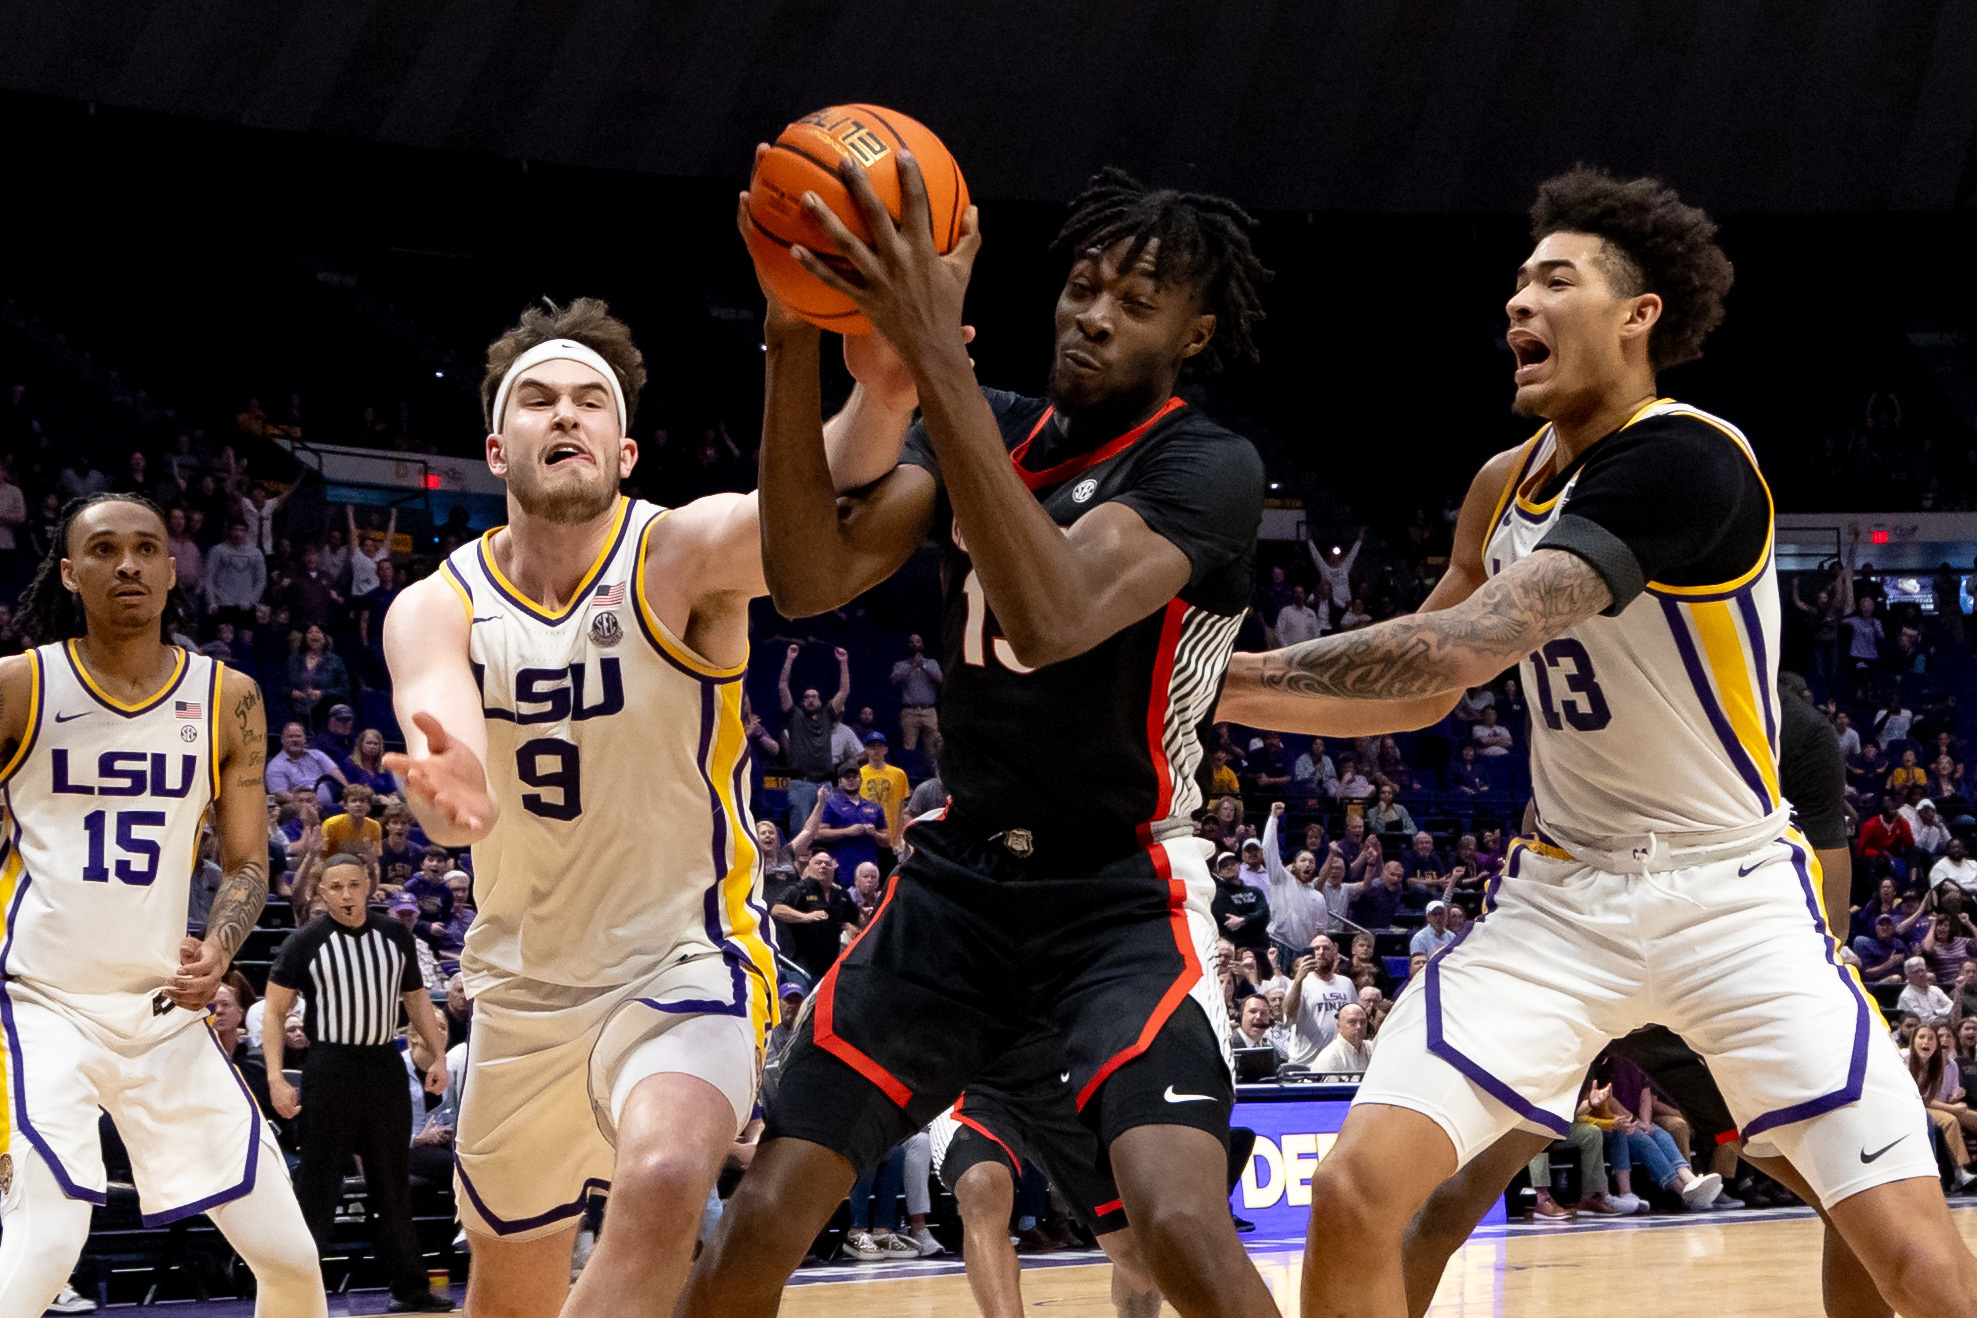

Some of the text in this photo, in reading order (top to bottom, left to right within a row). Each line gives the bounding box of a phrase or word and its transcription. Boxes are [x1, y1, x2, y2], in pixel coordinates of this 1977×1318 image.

[1074, 480, 1096, 502] SEC
[594, 613, 618, 637] SEC
[471, 657, 625, 726] LSU
[1530, 637, 1612, 732] 13
[181, 725, 197, 742] SEC
[51, 748, 198, 799] LSU
[516, 738, 583, 822] 9
[82, 810, 166, 887] 15
[1322, 992, 1348, 1001] LSU
